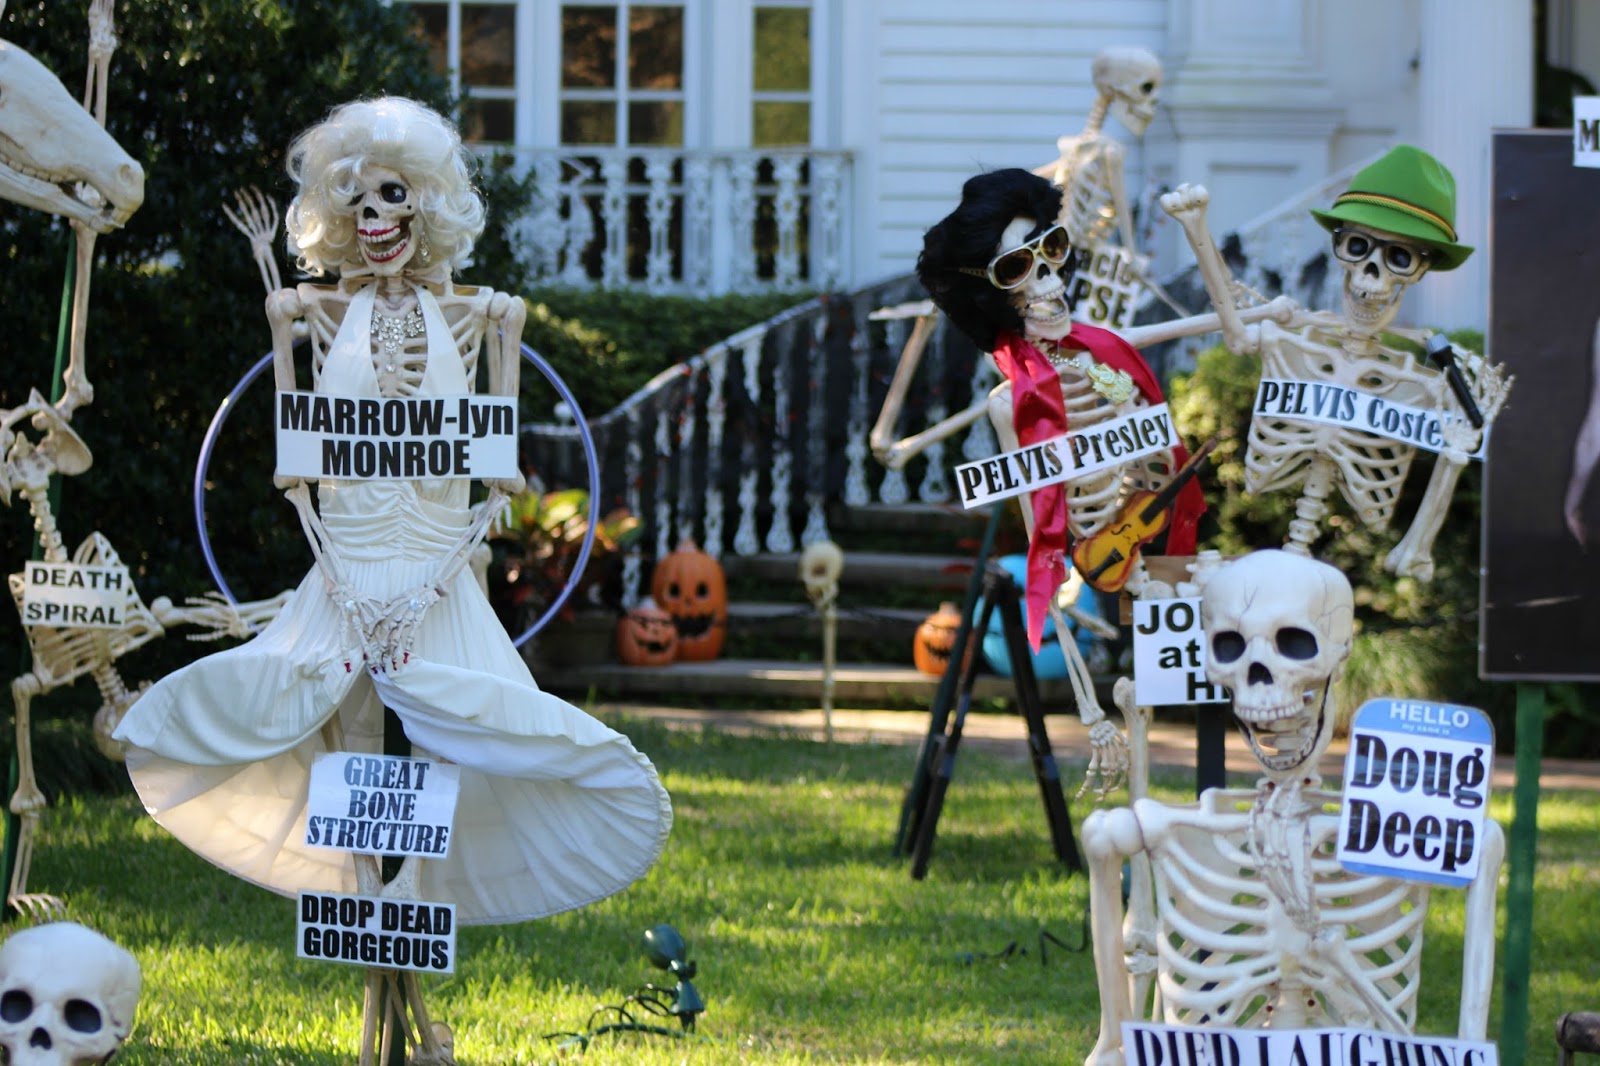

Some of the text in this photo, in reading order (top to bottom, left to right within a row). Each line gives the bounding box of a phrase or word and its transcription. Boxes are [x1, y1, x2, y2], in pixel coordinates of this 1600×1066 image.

[280, 393, 514, 439] MARROW-lyn
[1255, 380, 1484, 456] PELVIS Coste
[321, 438, 471, 478] MONROE
[959, 411, 1173, 501] PELVIS Presley
[31, 567, 122, 591] DEATH
[26, 602, 122, 625] SPIRAL
[1136, 601, 1204, 636] JO
[1158, 637, 1202, 670] at
[1186, 671, 1231, 702] H
[1389, 701, 1470, 729] HELLO
[343, 755, 430, 791] GREAT
[1349, 733, 1486, 810] Doug
[346, 788, 417, 822] BONE
[306, 815, 449, 855] STRUCTURE
[1343, 798, 1476, 873] Deep
[301, 893, 452, 936] DROP DEAD
[303, 926, 449, 970] GORGEOUS
[1129, 1028, 1241, 1066] DIED
